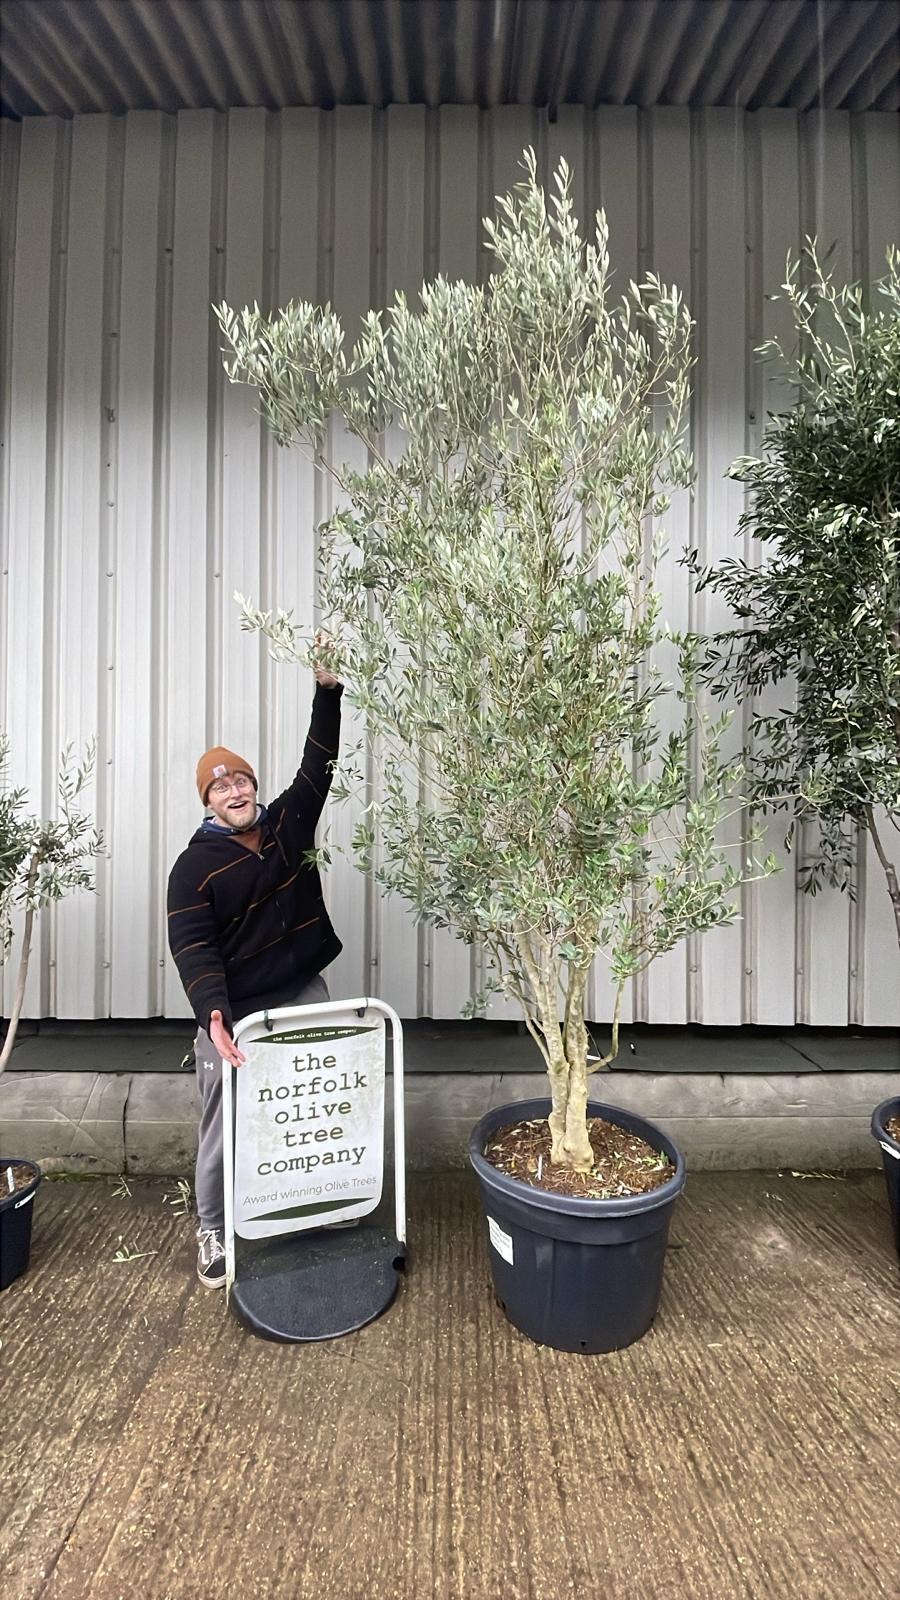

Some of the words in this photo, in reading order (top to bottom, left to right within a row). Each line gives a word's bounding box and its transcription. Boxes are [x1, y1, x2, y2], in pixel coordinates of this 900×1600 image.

[292, 1053, 337, 1073] the
[258, 1072, 368, 1103] norfolk
[274, 1101, 352, 1125] olive
[284, 1126, 344, 1148] tree
[257, 1146, 367, 1176] company
[243, 1192, 278, 1206] Award
[279, 1185, 322, 1200] winning
[325, 1180, 350, 1192] Olive
[351, 1176, 377, 1188] Trees
